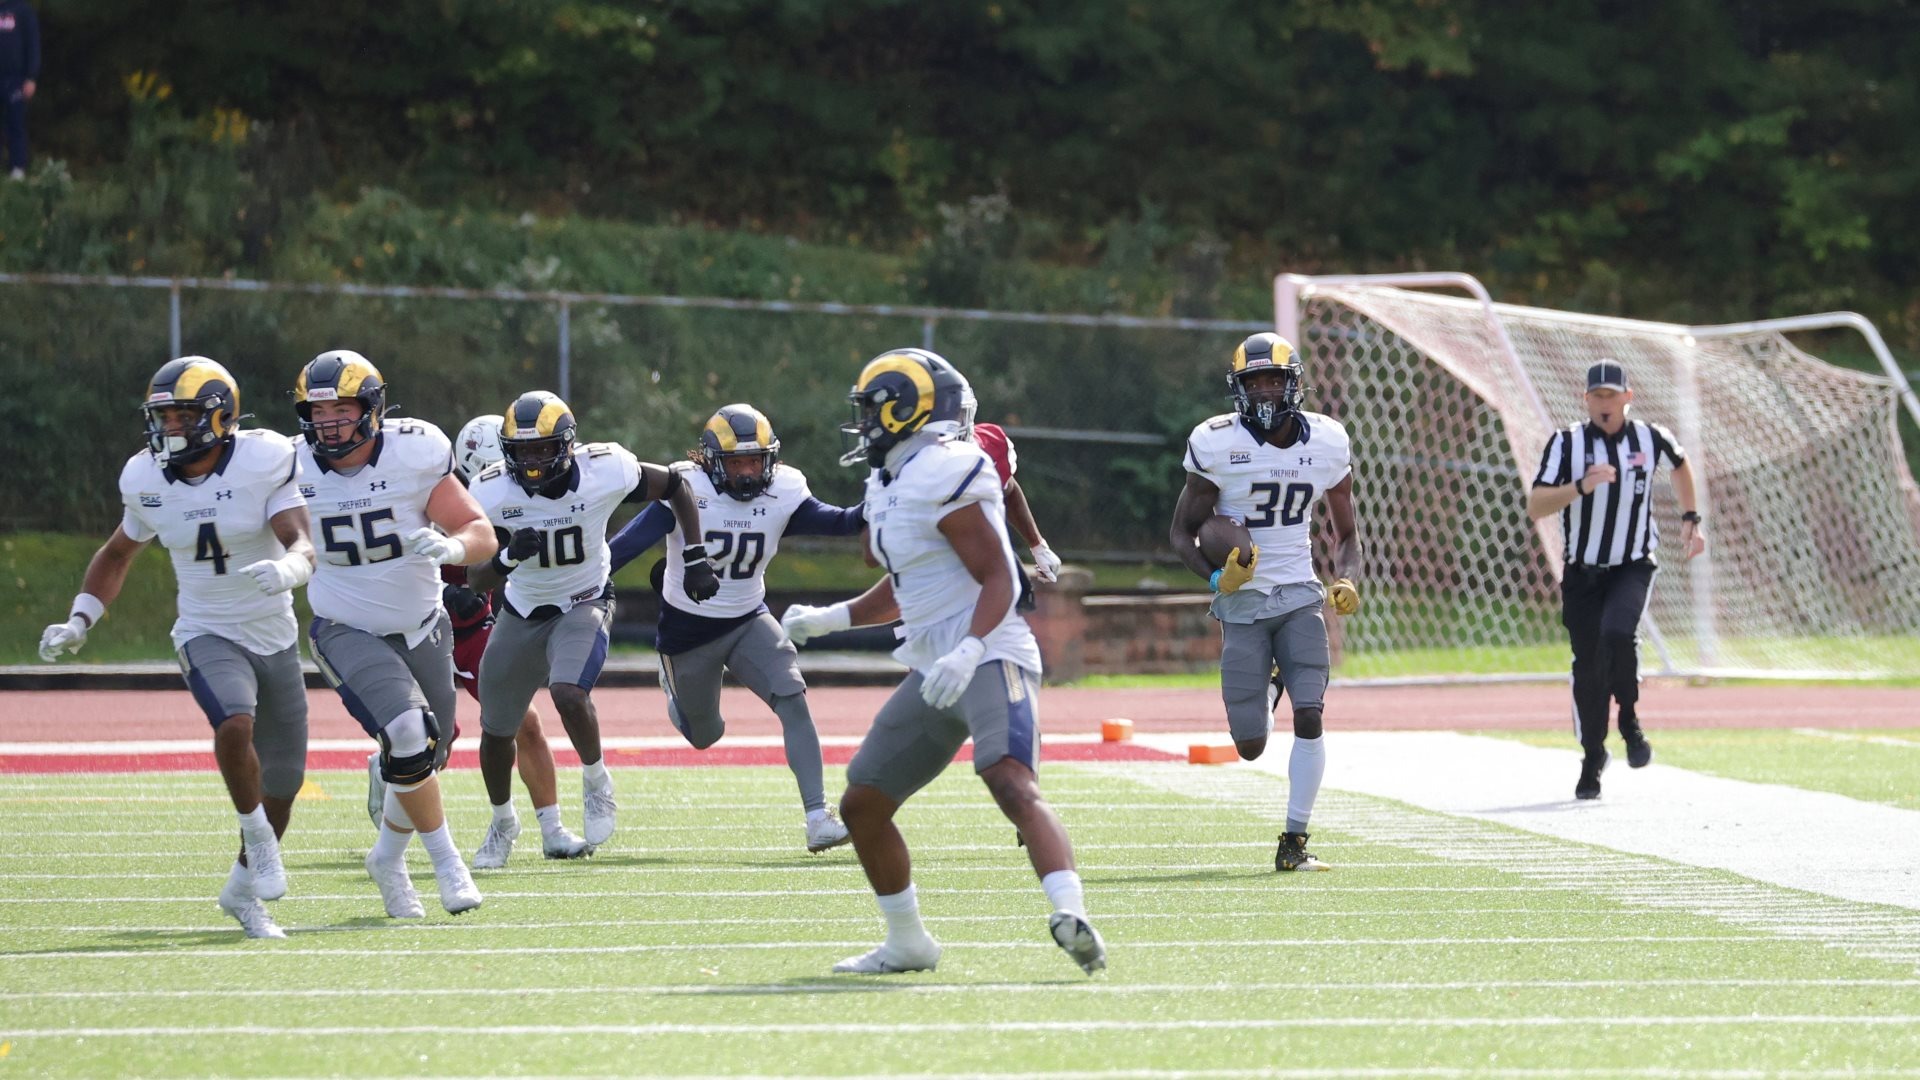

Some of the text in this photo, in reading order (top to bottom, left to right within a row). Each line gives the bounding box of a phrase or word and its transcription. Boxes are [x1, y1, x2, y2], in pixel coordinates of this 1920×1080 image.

[1270, 469, 1299, 479] SHEPHERD
[1635, 480, 1645, 494] S
[139, 495, 162, 504] PSAC
[337, 498, 372, 511] SHEPHERD
[1245, 482, 1314, 528] 30
[502, 508, 524, 517] PSAC
[542, 516, 573, 528] SHEPHERD
[723, 520, 752, 529] SHEPHERD
[320, 507, 404, 567] 55
[194, 521, 231, 577] 4
[538, 525, 585, 568] 10
[704, 530, 766, 580] 20
